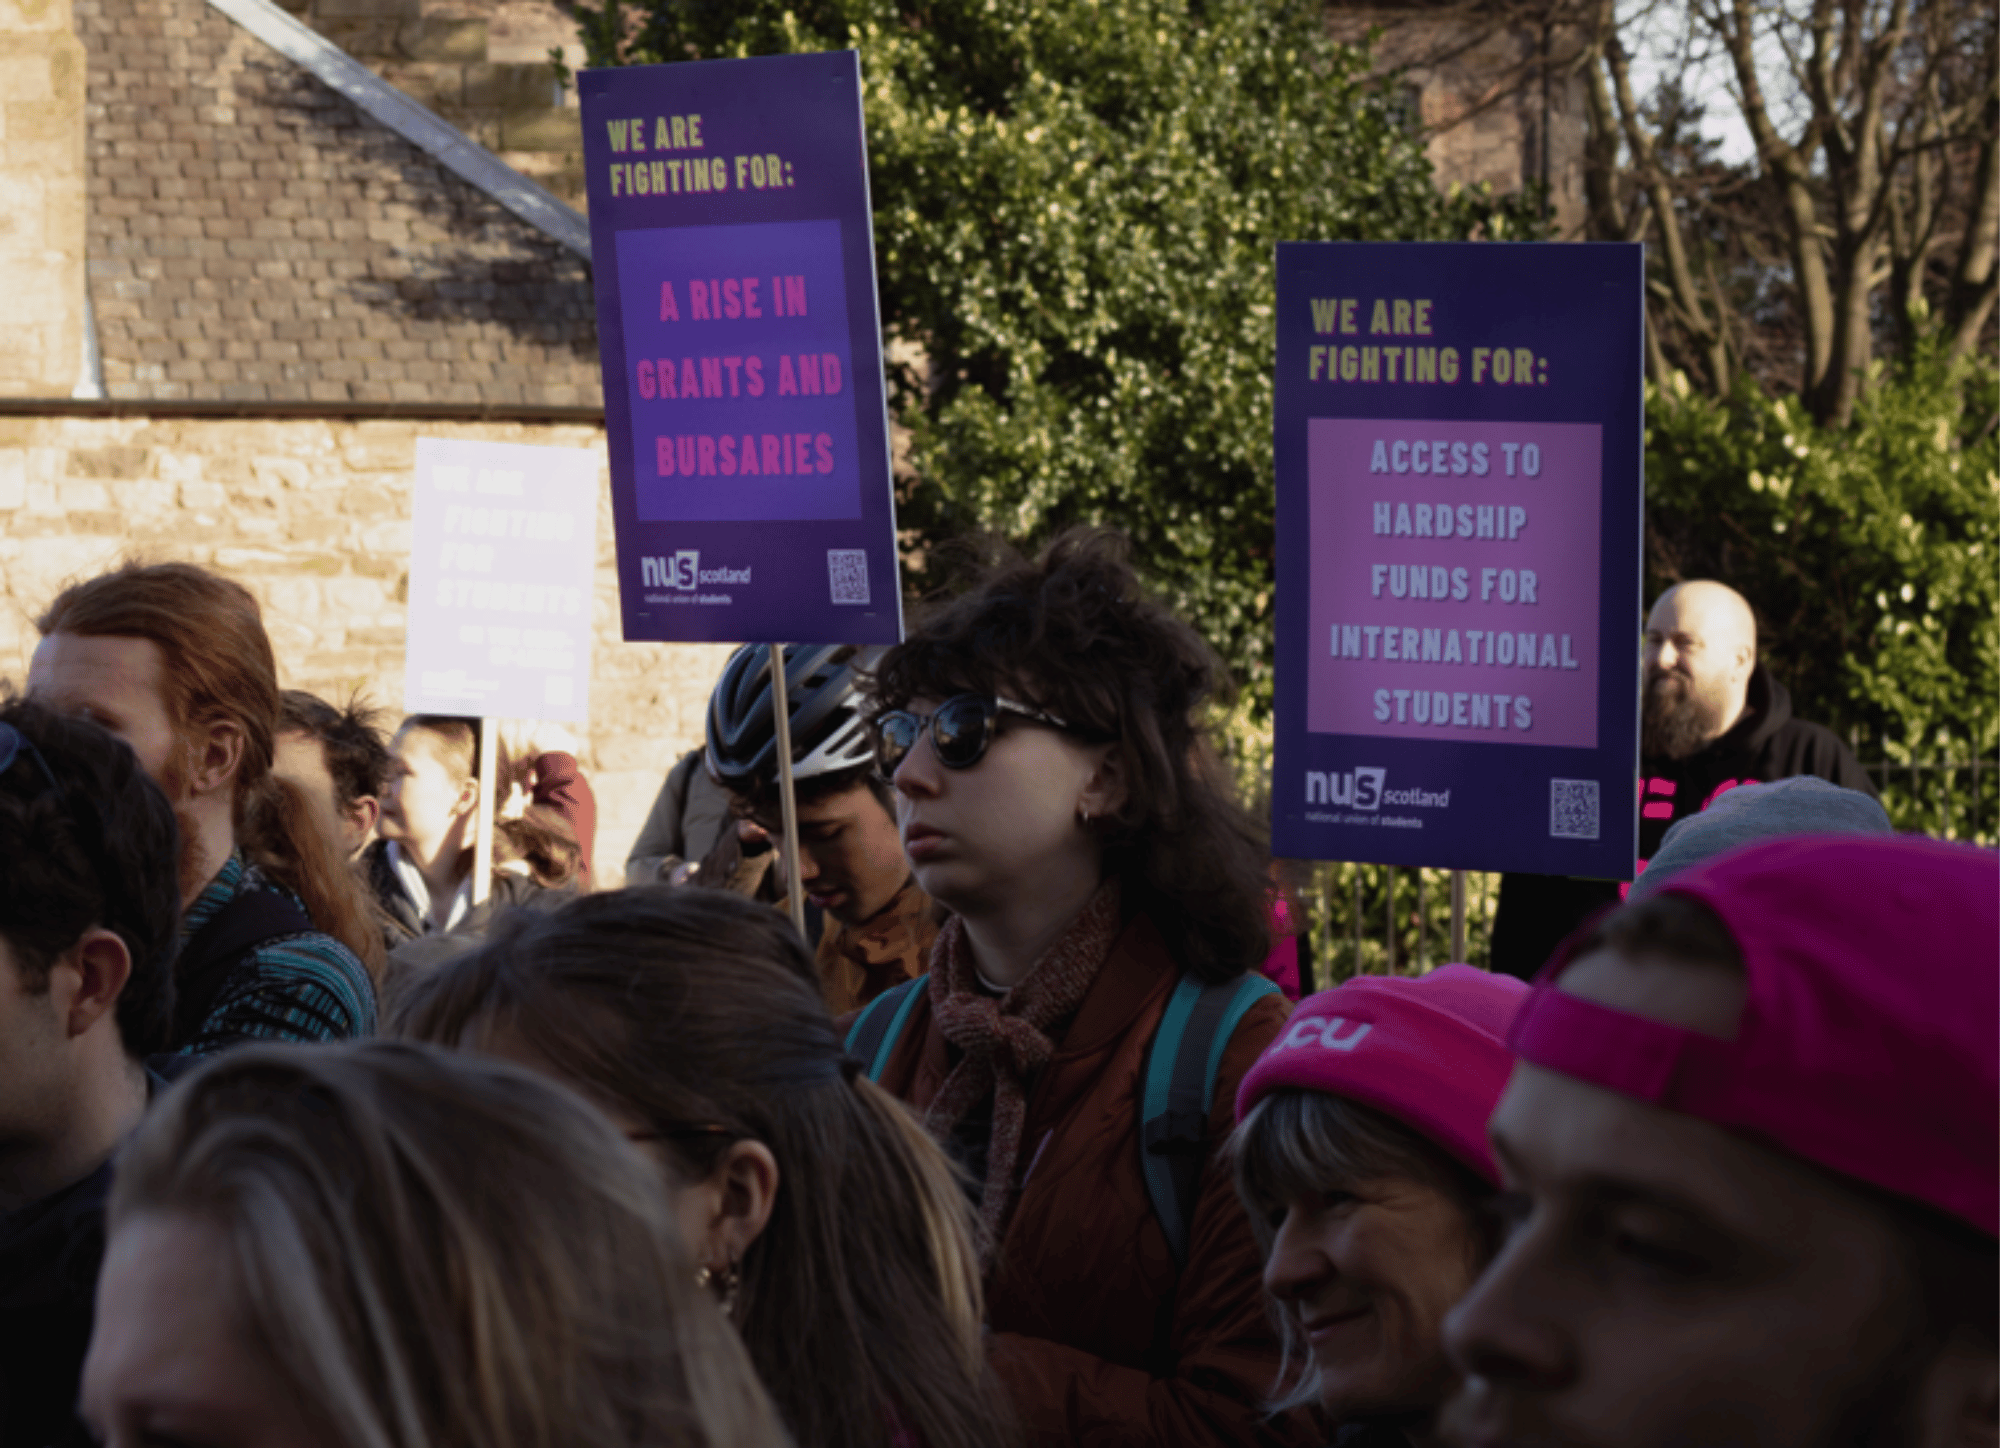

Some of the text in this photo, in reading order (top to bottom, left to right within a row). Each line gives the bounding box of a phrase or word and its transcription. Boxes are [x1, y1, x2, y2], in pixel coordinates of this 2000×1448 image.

[606, 113, 704, 153] WE ARE
[610, 153, 795, 197] FIGHTING FOR:
[659, 275, 808, 322] A RISE IN
[1310, 298, 1433, 336] WE ARE
[636, 353, 842, 400] GRANTS AND
[1309, 345, 1550, 385] FIGHTING FOR:
[655, 432, 834, 477] BURSARIES
[1370, 439, 1541, 478] ACCESS TO
[1373, 502, 1528, 540] HARDSHIP
[641, 550, 751, 590] nus scotland
[1371, 564, 1538, 604] FUNDS FOR
[1330, 623, 1580, 669] INTERNATIONAL
[1373, 688, 1532, 731] STUDENTS
[1305, 766, 1450, 810] nus scotland
[1381, 815, 1422, 829] students
